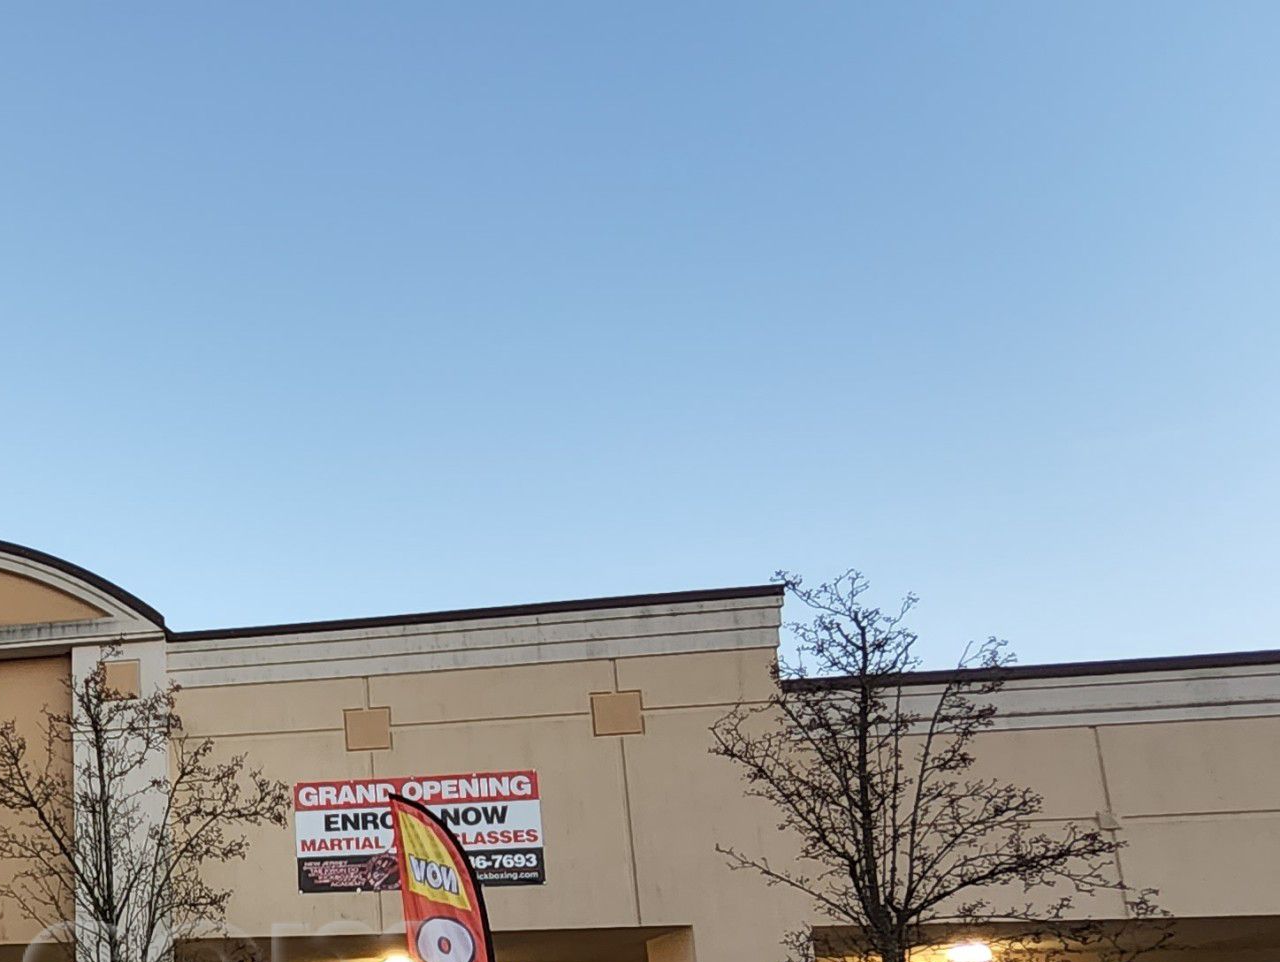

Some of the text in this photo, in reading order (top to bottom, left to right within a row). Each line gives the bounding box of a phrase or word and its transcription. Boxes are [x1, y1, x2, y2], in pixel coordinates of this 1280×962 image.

[298, 775, 532, 807] GRAND OPENING
[324, 804, 509, 832] ENRO NOW
[300, 828, 539, 853] MARTIAL LASSES
